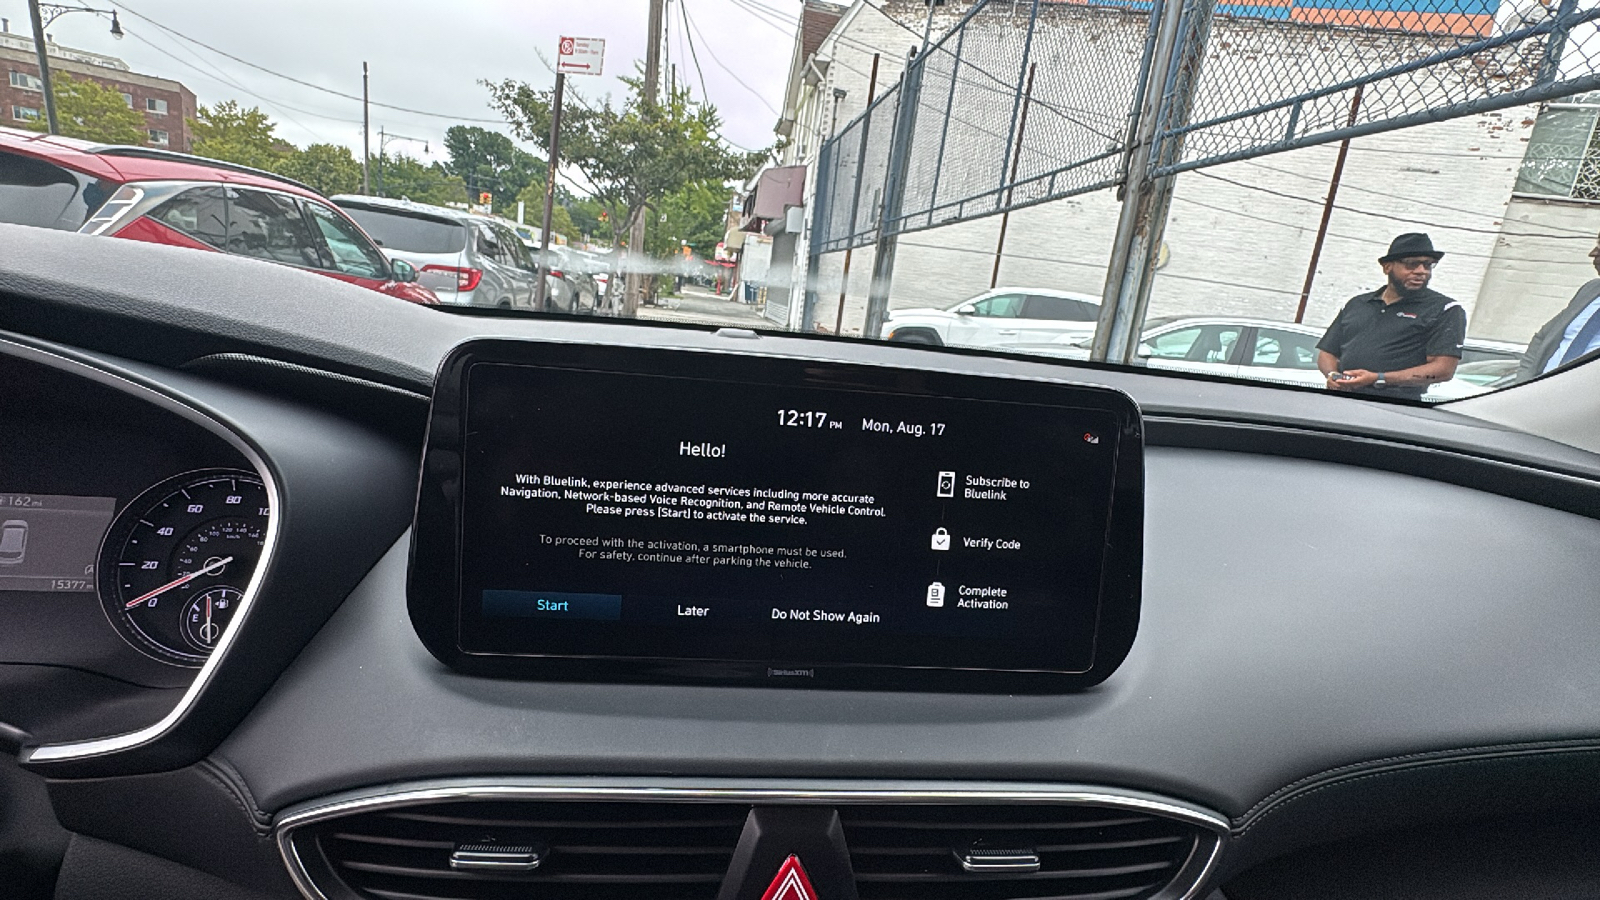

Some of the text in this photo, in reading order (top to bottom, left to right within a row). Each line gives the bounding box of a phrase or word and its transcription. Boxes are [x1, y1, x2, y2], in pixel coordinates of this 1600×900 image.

[777, 409, 843, 430] 12:17 PM
[931, 423, 945, 435] 17
[680, 442, 725, 457] Hello!
[966, 475, 1030, 489] Subscribe to
[516, 474, 540, 484] With
[593, 480, 652, 490] experience
[655, 483, 704, 494] advanced
[708, 487, 750, 497] services
[754, 488, 799, 501] including
[803, 493, 828, 501] more
[832, 495, 874, 504] accurate
[965, 488, 1006, 500] Bluelink
[225, 495, 242, 504] 80
[565, 490, 646, 503] Network-based
[650, 495, 677, 505] Voice
[747, 501, 765, 510] and
[768, 501, 807, 512] Remote
[810, 504, 845, 514] Vehicle
[187, 504, 203, 513] 60
[587, 503, 622, 514] Please
[625, 508, 655, 517] press
[693, 510, 703, 519] to
[707, 511, 747, 521] activate
[750, 513, 765, 522] the
[157, 527, 174, 536] 40
[540, 535, 552, 544] To
[555, 537, 598, 548] proceed
[602, 538, 624, 548] with
[628, 539, 644, 548] the
[713, 544, 773, 556] smartphone
[777, 547, 802, 556] must
[806, 548, 817, 557] be
[964, 537, 1020, 550] Verify Code
[579, 549, 597, 558] For
[638, 553, 682, 562] continue
[685, 554, 710, 563] after
[713, 556, 752, 567] parking
[755, 557, 771, 567] the
[141, 561, 159, 570] 20
[959, 585, 1007, 598] Complete
[148, 597, 158, 607] 0
[538, 600, 568, 611] Start
[957, 598, 1008, 609] Activation
[678, 605, 709, 616] Later
[772, 608, 880, 624] Do Not Show Again
[192, 614, 199, 623] E
